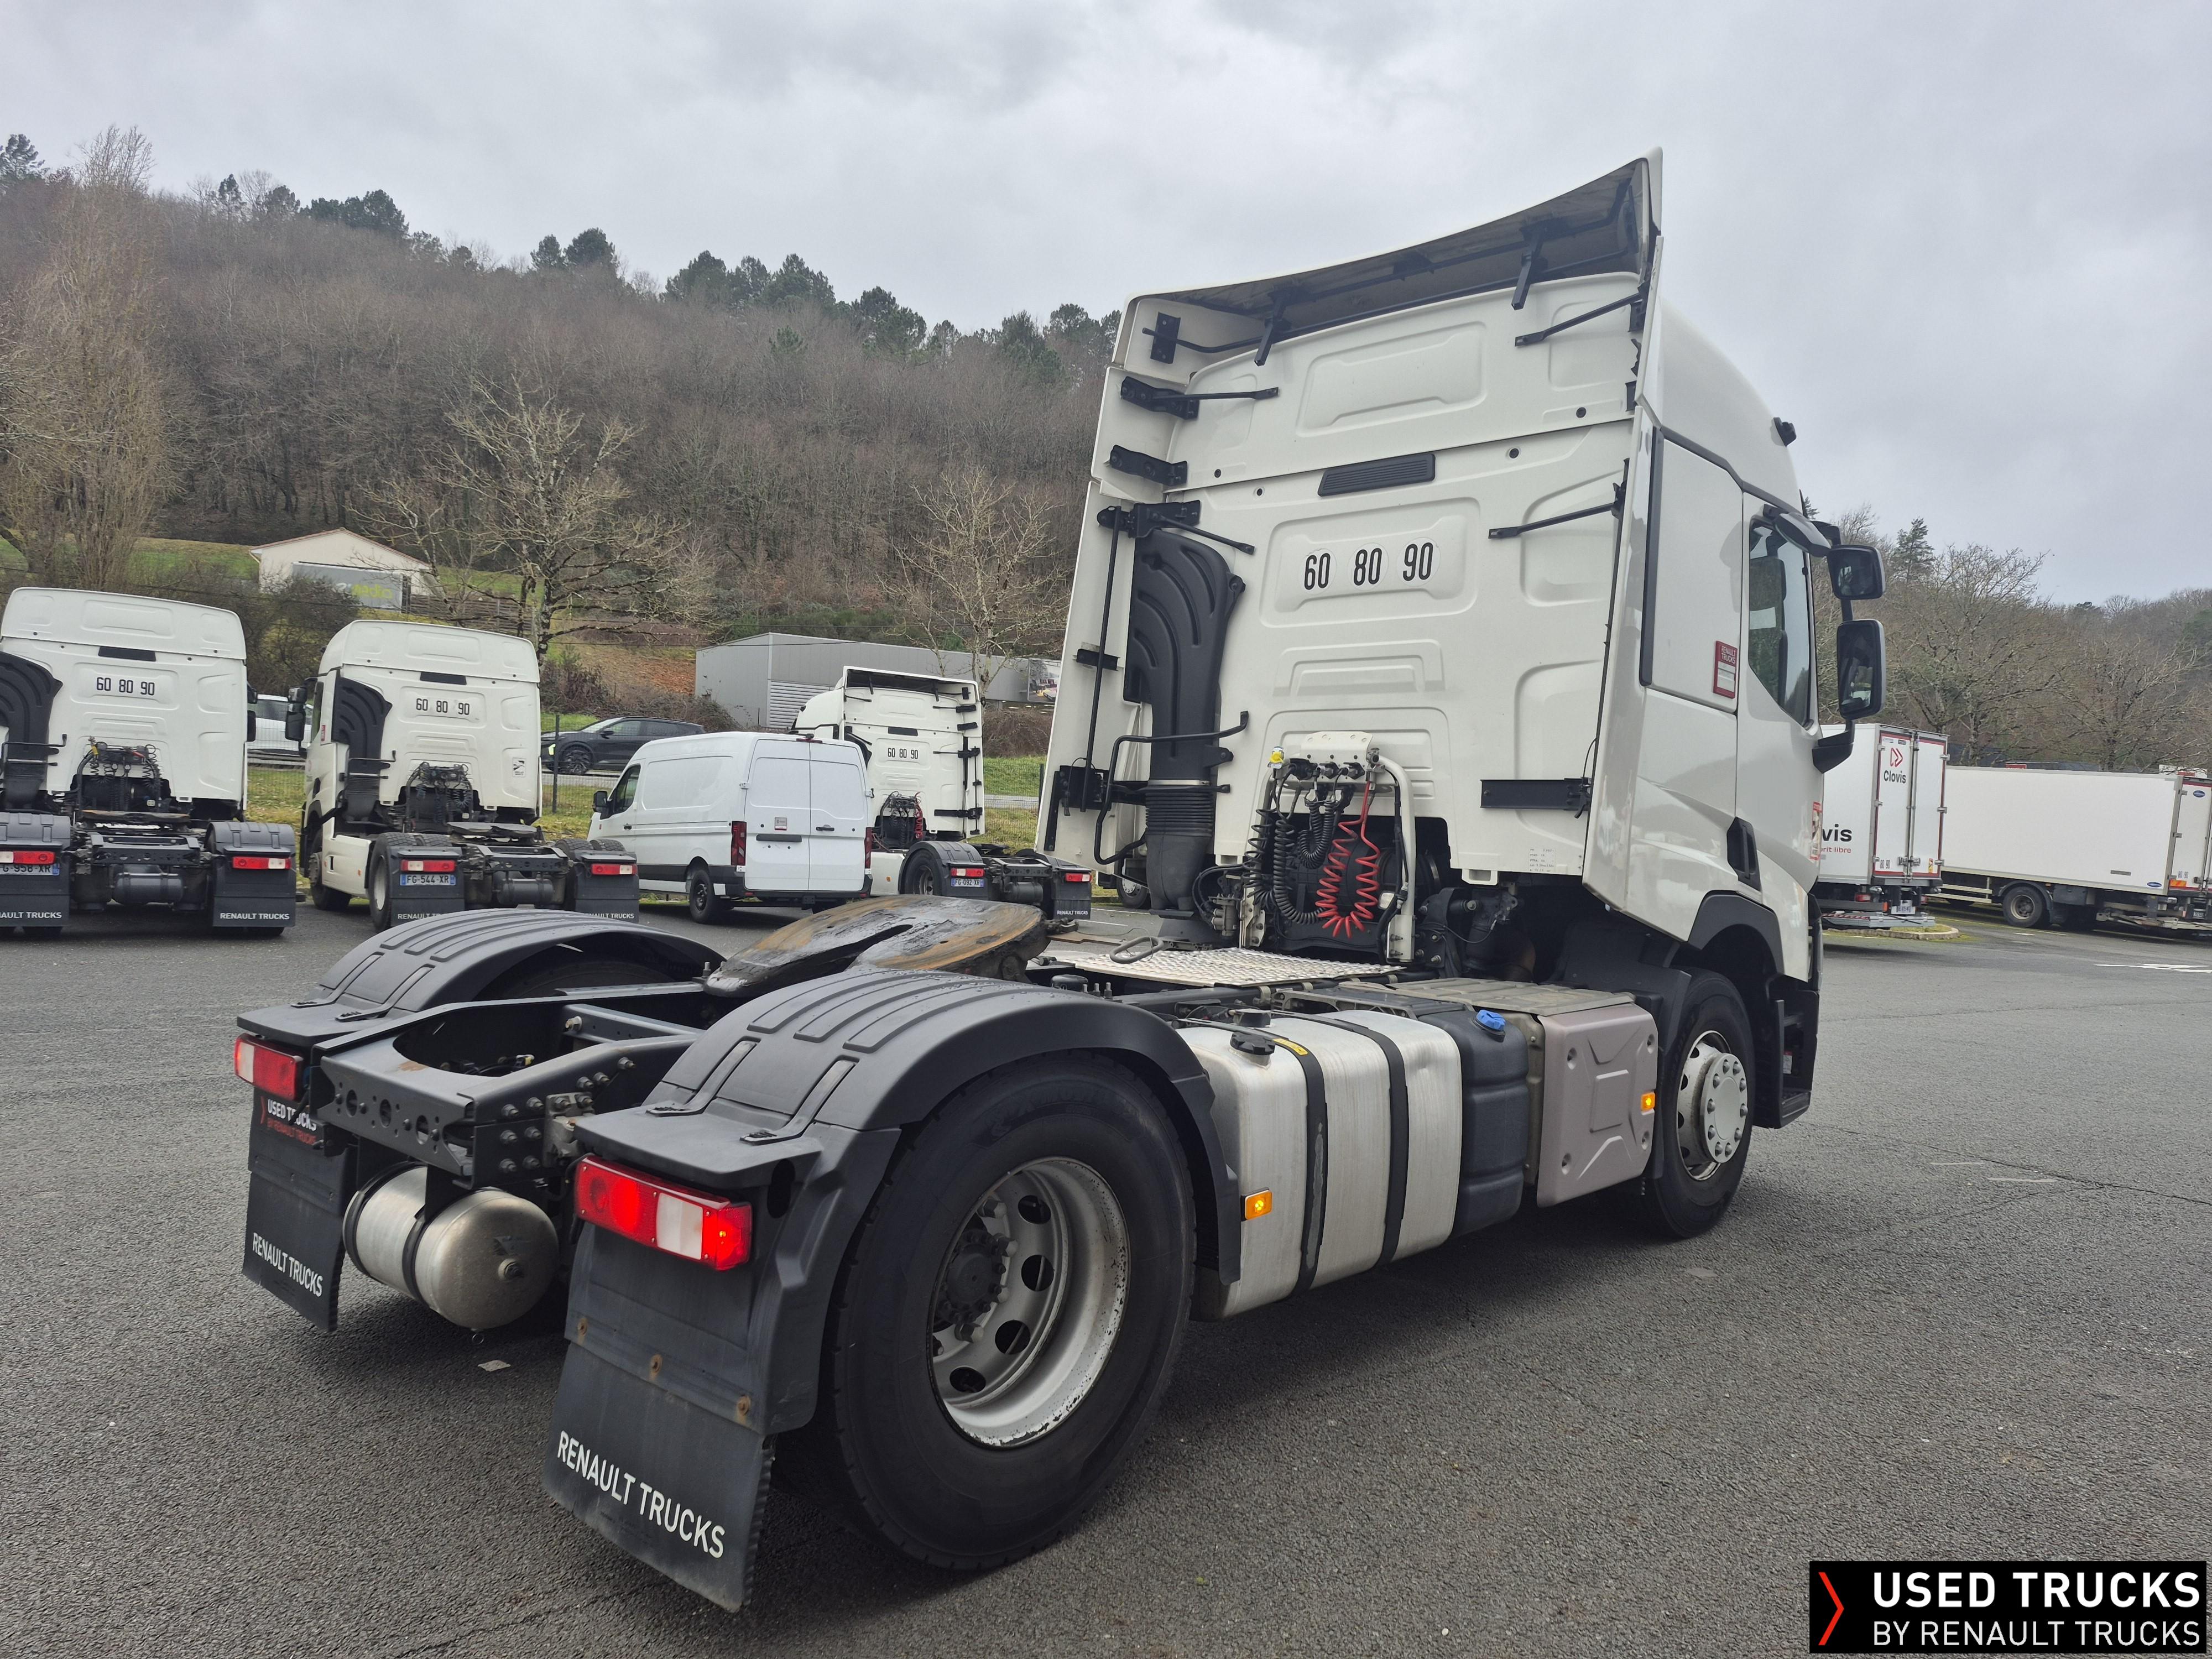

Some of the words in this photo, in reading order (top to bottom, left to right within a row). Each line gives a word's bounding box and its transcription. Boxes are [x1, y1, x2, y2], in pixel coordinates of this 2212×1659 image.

[1304, 553, 1331, 590] 60
[1354, 548, 1382, 586] 80
[1403, 542, 1433, 581] 90
[97, 677, 111, 691] 60
[119, 679, 133, 693] 80
[140, 681, 155, 696] 90
[416, 698, 428, 711] 60
[436, 701, 448, 713] 80
[458, 703, 470, 715] 90
[888, 748, 895, 758] 60
[899, 748, 907, 758] 80
[911, 750, 918, 759] 90
[1884, 770, 1906, 784] Clovis
[268, 1098, 286, 1119] USED
[253, 1232, 288, 1272] RENAULT
[289, 1256, 323, 1297] TRUCKS
[557, 1430, 636, 1505] RENAULT
[640, 1482, 725, 1558] TRUCKS
